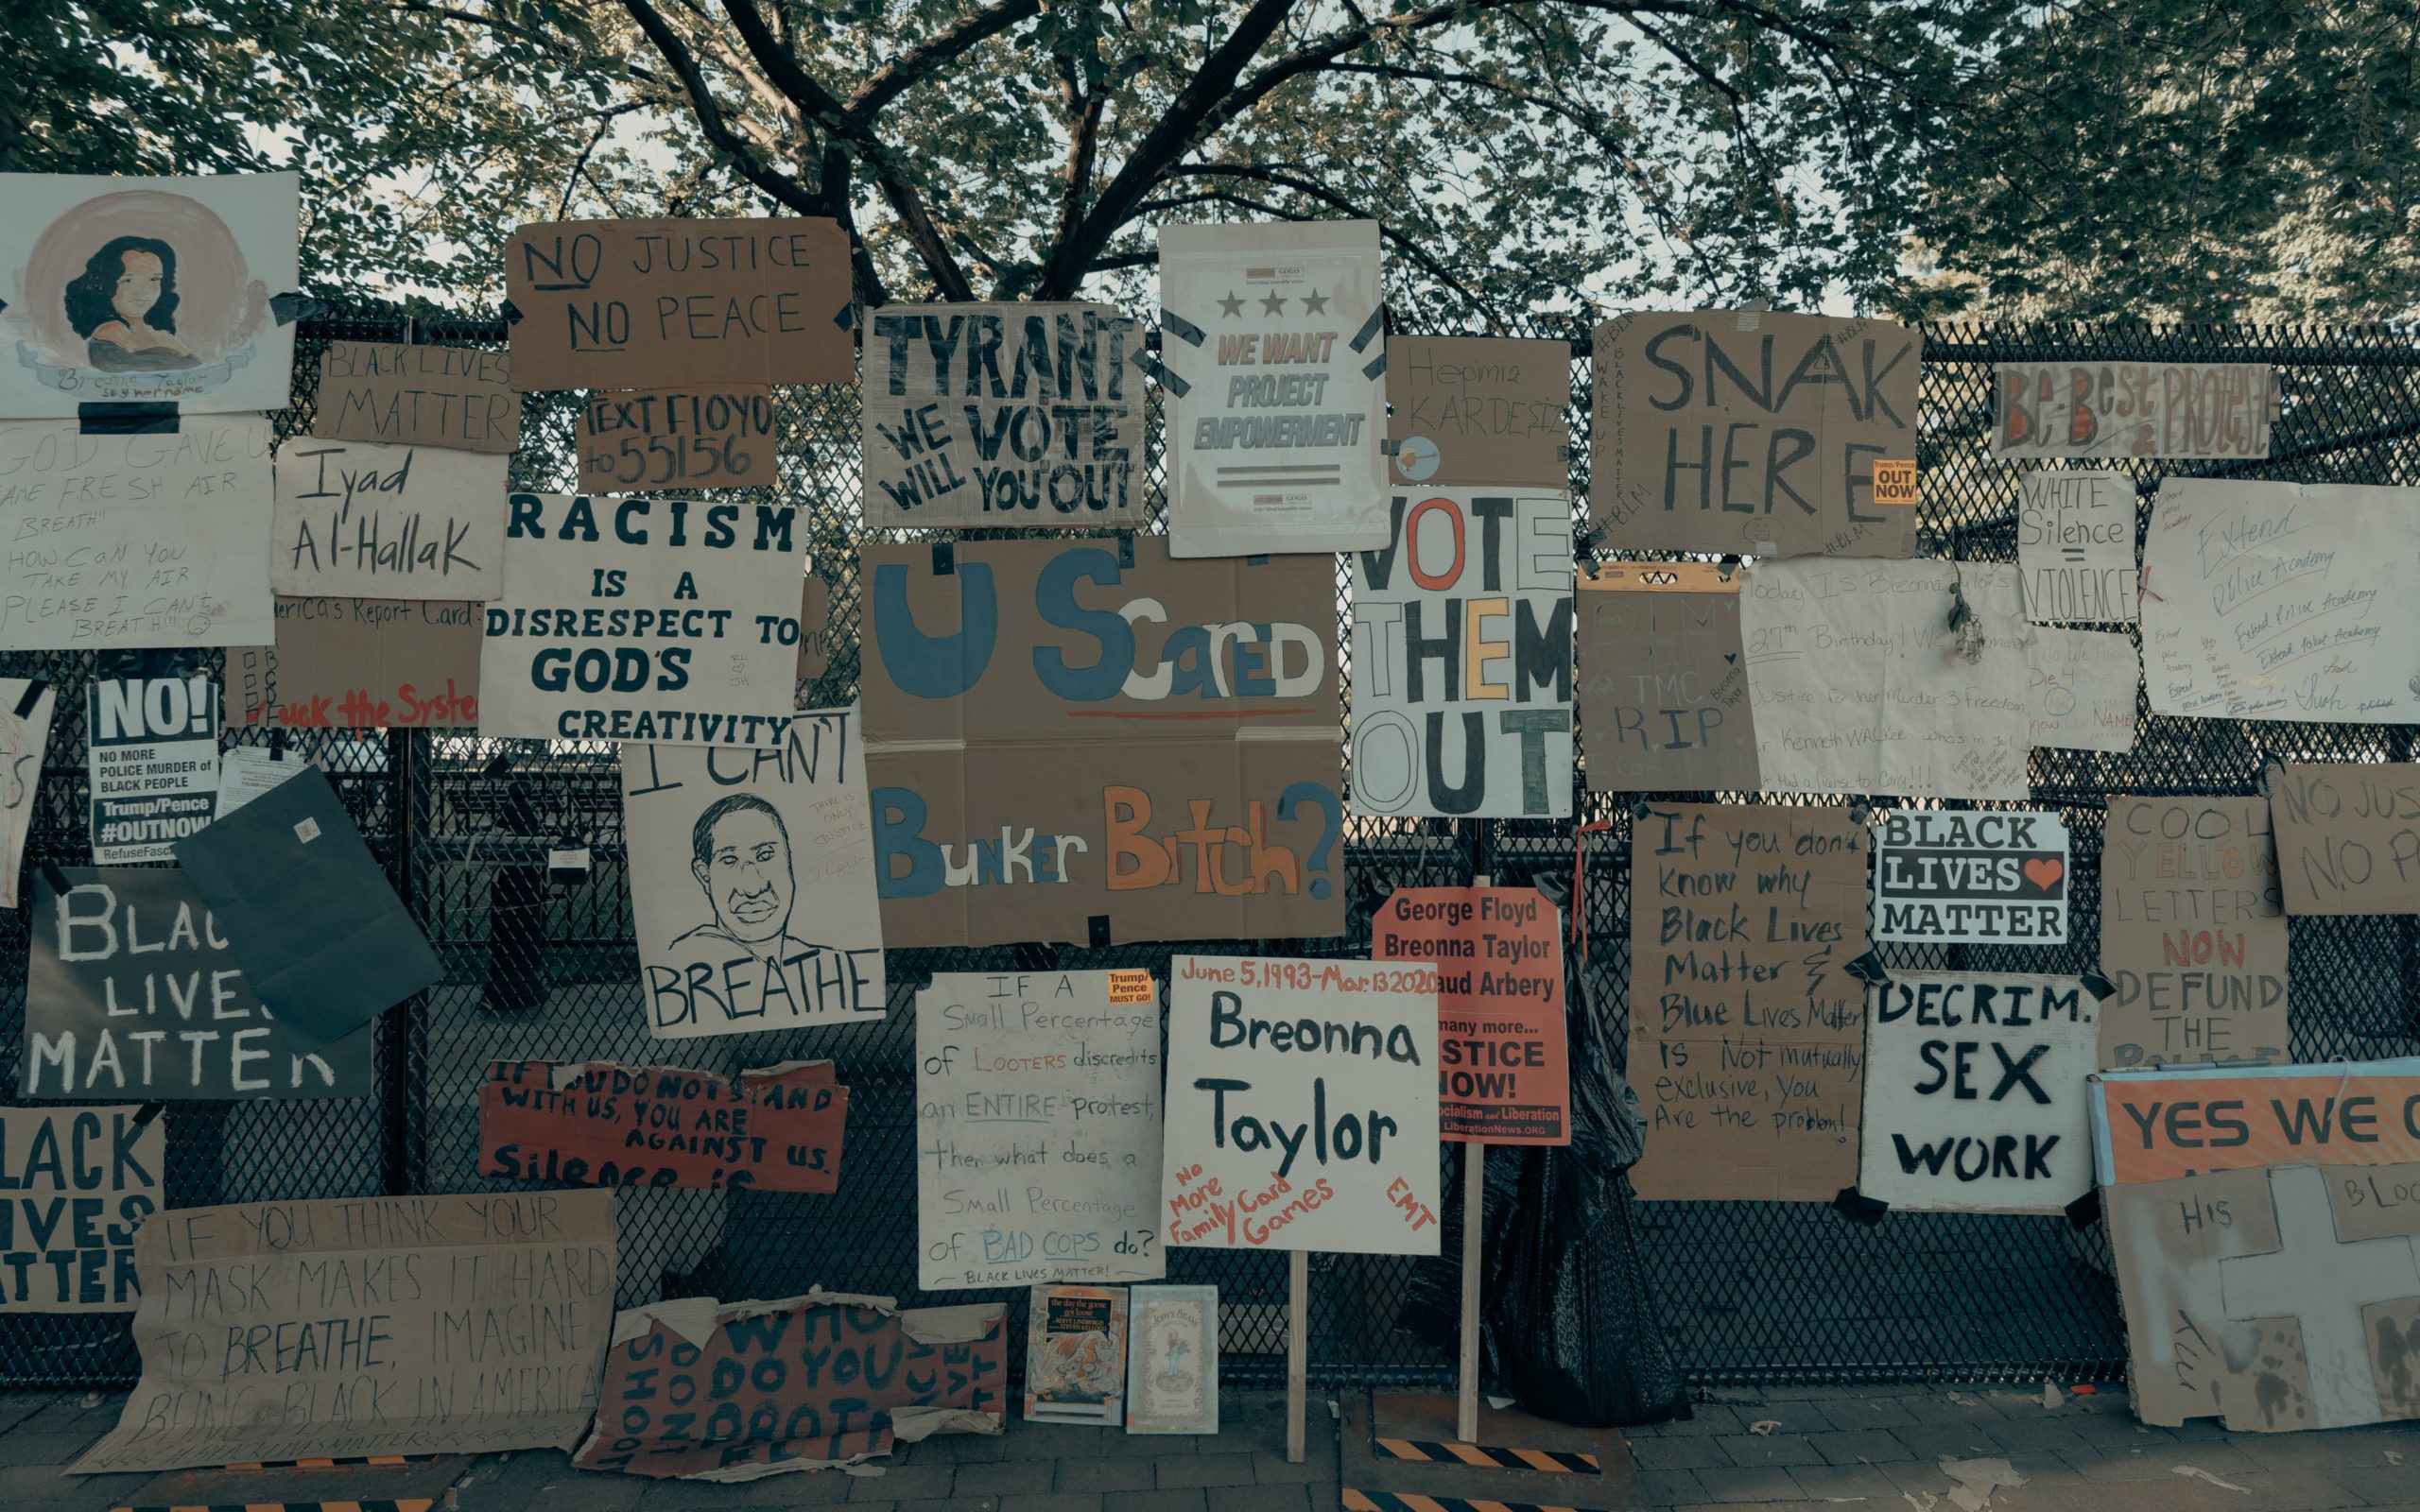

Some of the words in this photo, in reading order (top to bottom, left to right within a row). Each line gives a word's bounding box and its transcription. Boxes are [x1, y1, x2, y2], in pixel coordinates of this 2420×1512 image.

[524, 234, 601, 283] NO
[631, 234, 810, 273] JUSTICE
[568, 301, 630, 349] NO
[657, 293, 804, 340] PEACE
[328, 344, 407, 378] BLACK
[420, 350, 511, 385] LIVES
[873, 311, 1135, 401] TYRANT
[1218, 333, 1259, 366] WE
[1262, 332, 1338, 365] WANT
[1227, 373, 1330, 408] PROJECT
[1645, 324, 1913, 429] SNAK
[337, 388, 510, 442] MATTER
[585, 396, 658, 436] TEXT
[666, 393, 773, 436] FLOYD
[875, 403, 953, 461] WE
[963, 405, 1129, 463] VOTE
[1194, 413, 1366, 450] EMPOWERMENT
[585, 446, 614, 473] to
[616, 433, 752, 484] 55156
[1663, 423, 1888, 524] HERE
[1879, 471, 1911, 484] OUT
[295, 449, 412, 524] Iyad
[878, 453, 966, 510] WILL
[973, 466, 1040, 511] YOU
[1048, 463, 1134, 513] OUT
[1876, 485, 1914, 498] NOW
[2019, 476, 2111, 509] WHITE
[507, 493, 795, 552] RACISM
[2021, 510, 2125, 545] Silence
[1360, 496, 1571, 592] VOTE
[23, 572, 81, 589] TAKE
[98, 569, 129, 589] MY
[145, 567, 189, 589] AIR
[591, 568, 627, 597] IS
[674, 571, 698, 599] A
[2020, 568, 2137, 621] VIOLENCE
[108, 595, 129, 616] I
[354, 597, 410, 629] Report
[486, 609, 732, 638] DISRESPECT
[755, 615, 800, 645] TO
[873, 561, 997, 698] U
[1354, 597, 1573, 703] THEM
[531, 647, 692, 693] GOD'S
[99, 678, 208, 738] NO!
[558, 710, 791, 746] CREATIVITY
[1614, 706, 1723, 751] RIP
[99, 751, 116, 763] NO
[121, 749, 156, 761] MORE
[100, 765, 143, 778] POLICE
[147, 761, 197, 775] MURDER
[200, 760, 212, 771] of
[1352, 710, 1570, 815] OUT
[100, 779, 141, 793] BLACK
[145, 777, 188, 790] PEOPLE
[2281, 774, 2342, 826] NO
[102, 798, 209, 817] Trump/Pence
[2127, 801, 2270, 840] COOL
[1653, 811, 1706, 859] If
[1725, 824, 1782, 868] you
[1883, 815, 2038, 850] BLACK
[1884, 856, 2022, 892] LIVES
[2118, 838, 2278, 881] YELLOW
[2302, 836, 2373, 901] NO
[1756, 862, 1811, 909] why
[1395, 897, 1474, 926] George
[1480, 897, 1536, 928] Floyd
[1660, 902, 1752, 946] Black
[1767, 906, 1843, 943] Lives
[1881, 903, 2063, 937] MATTER
[2116, 886, 2284, 924] LETTERS
[1384, 934, 1475, 957] Breonna
[1482, 934, 1550, 965] Taylor
[2163, 928, 2245, 969] NOW
[645, 949, 887, 1026] BREATHE
[986, 974, 1031, 998] IF
[1054, 974, 1074, 998] A
[1110, 973, 1149, 983] Trump/
[1182, 957, 1236, 983] June
[1479, 971, 1554, 1003] Arbery
[1664, 950, 1793, 988] Matter
[1113, 985, 1147, 993] Pence
[1878, 980, 2092, 1028] DECRIM.
[2116, 969, 2285, 1013] DEFUND
[1021, 1002, 1154, 1038] Percentage
[1210, 990, 1420, 1066] Breonna
[1439, 1019, 1477, 1036] many
[1482, 1022, 1539, 1035] more...
[1660, 992, 1733, 1034] Blue
[1743, 988, 1801, 1029] Lives
[2152, 1016, 2233, 1052] THE
[925, 1045, 960, 1075] of
[975, 1046, 1067, 1072] LOOTERS
[1074, 1040, 1158, 1068] discredits
[1914, 1040, 2052, 1106] SEX
[965, 1091, 1059, 1118] ENTIRE
[1654, 1073, 1770, 1103] exclusive,
[633, 1100, 681, 1133] YOU
[695, 1109, 747, 1134] ARE
[1193, 1076, 1397, 1177] Taylor
[1443, 1122, 1547, 1135] LiberationNews.ORG
[1501, 1107, 1560, 1121] Liberation
[1655, 1104, 1698, 1132] Are
[1709, 1105, 1756, 1129] the
[2121, 1100, 2251, 1150] YES
[2271, 1095, 2380, 1145] WE
[625, 1129, 768, 1163] AGAINST
[994, 1143, 1048, 1166] what
[1063, 1140, 1108, 1164] does
[1123, 1153, 1138, 1167] a
[1891, 1133, 2062, 1182] WORK
[1027, 1187, 1139, 1222] Percentage
[1242, 1177, 1334, 1245] Games
[1387, 1176, 1437, 1232] EMT
[165, 1213, 216, 1262] IF
[239, 1205, 315, 1249] YOU
[334, 1200, 447, 1246] THINK
[471, 1195, 562, 1236] YOUR
[928, 1232, 965, 1262] of
[983, 1228, 1034, 1260] BAD
[1044, 1230, 1100, 1258] COPS
[1114, 1228, 1154, 1258] do?
[164, 1263, 271, 1322] MASK
[297, 1252, 423, 1311] MAKES
[450, 1254, 491, 1304] IT
[512, 1246, 611, 1300] HARD
[964, 1267, 1009, 1284] BLACK
[1014, 1267, 1046, 1280] LIVES
[1053, 1264, 1110, 1278] MATTER!
[222, 1314, 396, 1383] BREATHE,
[432, 1300, 586, 1364] IMAGINE
